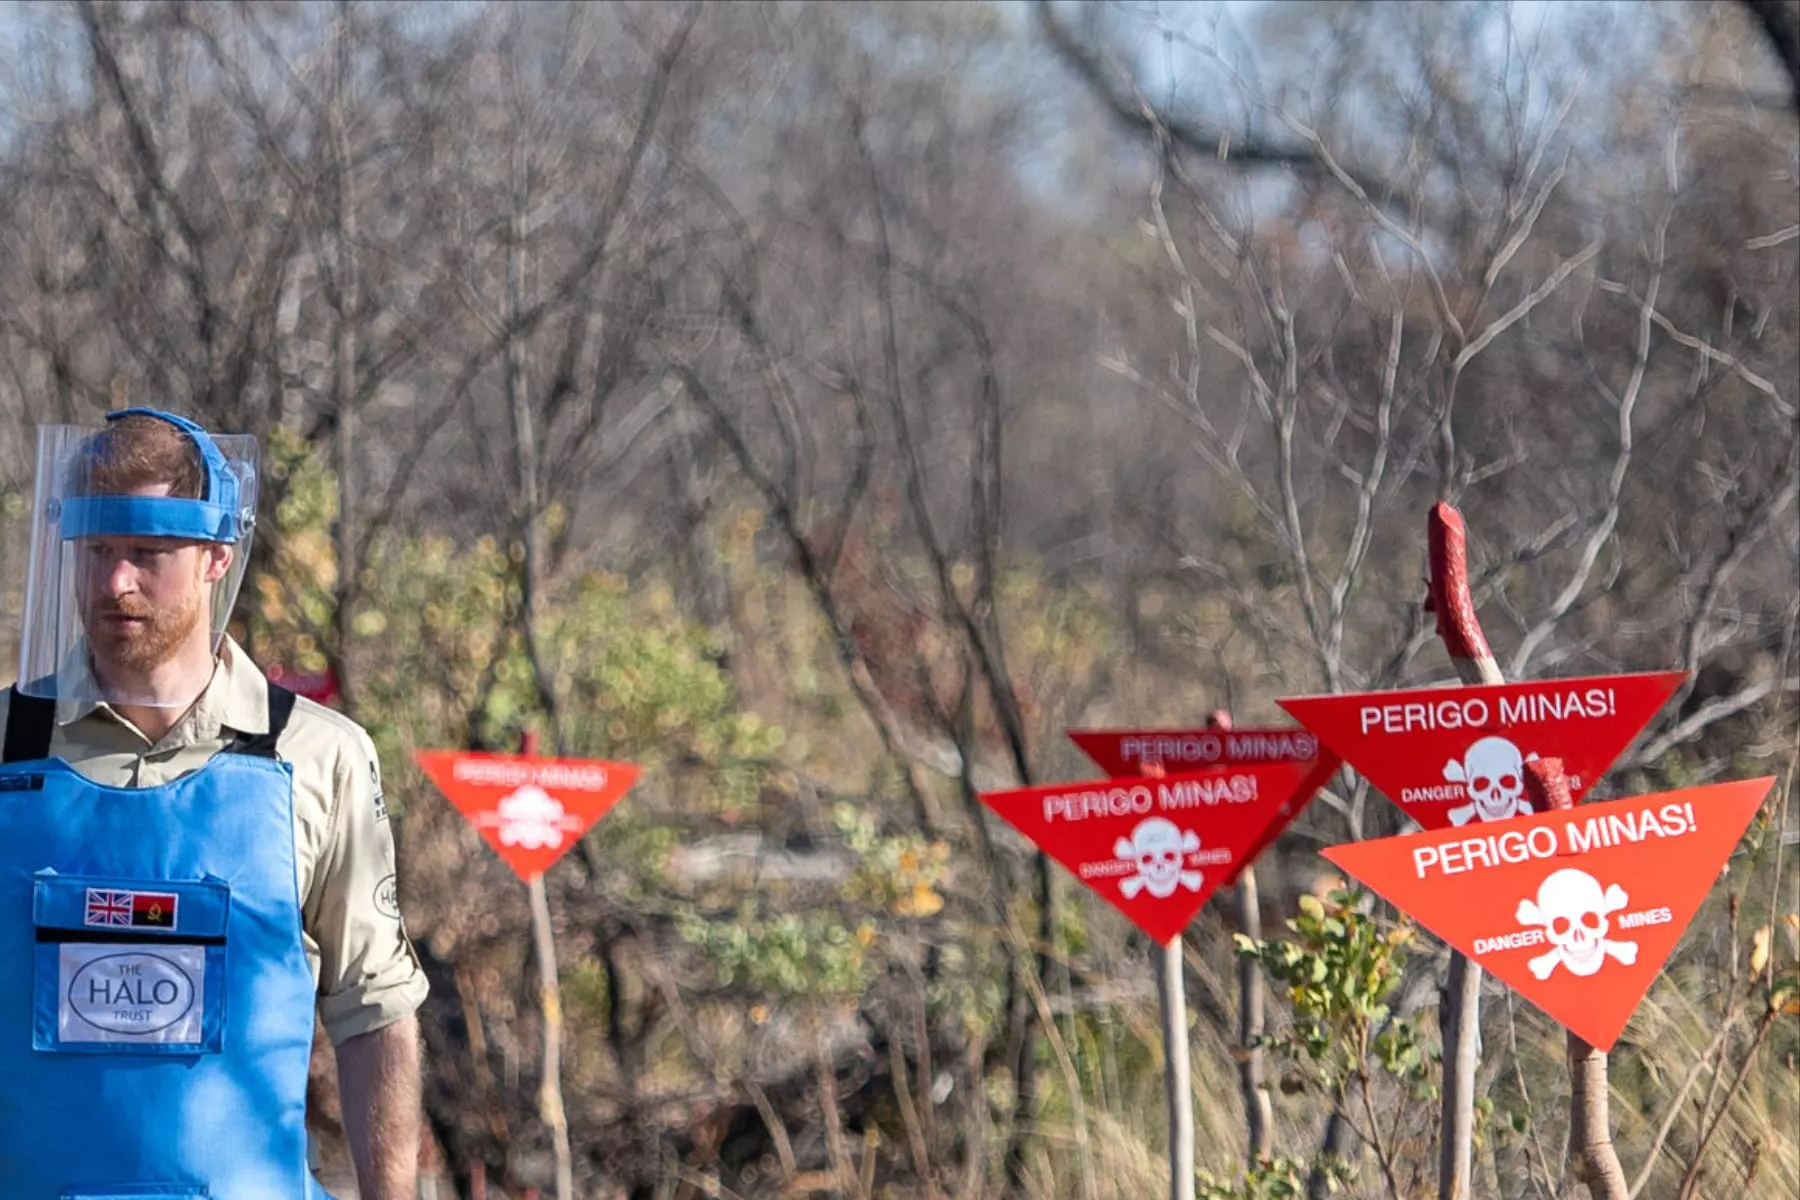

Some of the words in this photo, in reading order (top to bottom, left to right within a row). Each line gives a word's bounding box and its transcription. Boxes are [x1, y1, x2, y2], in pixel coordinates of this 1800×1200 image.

[1360, 699, 1488, 734] PERIGO
[1500, 688, 1616, 725] MINAS!
[1119, 734, 1222, 762] PERIGO
[1226, 732, 1318, 761] MINAS!
[1043, 785, 1152, 823] PERIGO
[1157, 773, 1258, 810] MINAS!
[1401, 784, 1465, 804] DANGER
[1412, 825, 1558, 880] PERIGO
[1565, 802, 1697, 853] MINAS!
[1473, 929, 1545, 956] DANGER
[1617, 907, 1672, 930] MINES
[118, 963, 143, 976] THE
[89, 979, 178, 1006] HALO
[113, 1009, 153, 1022] TRUST
